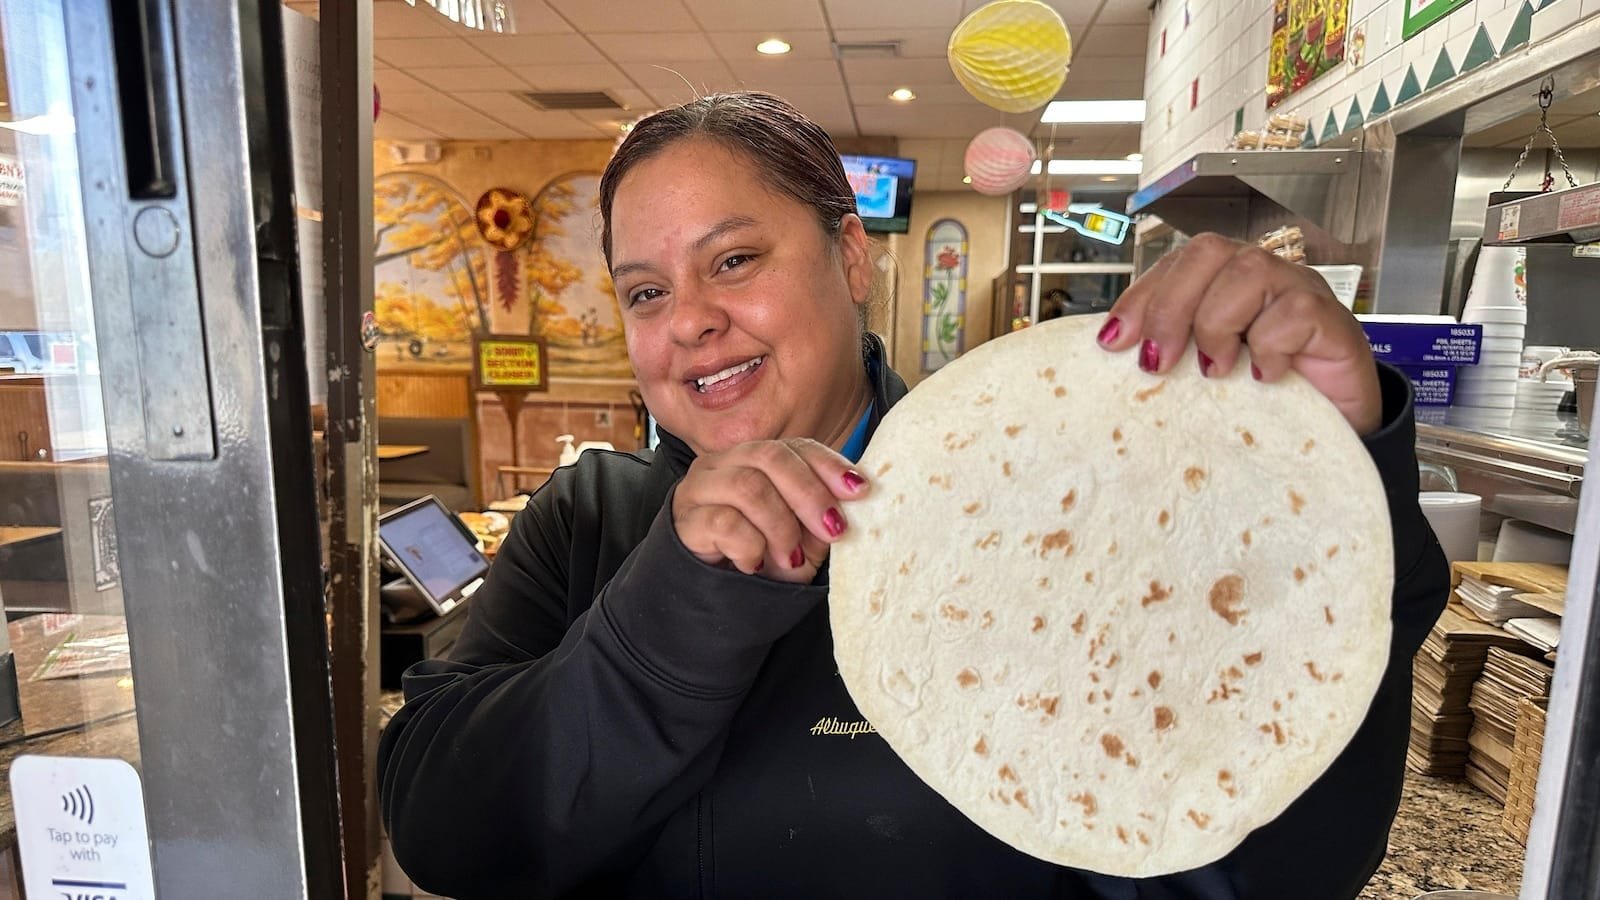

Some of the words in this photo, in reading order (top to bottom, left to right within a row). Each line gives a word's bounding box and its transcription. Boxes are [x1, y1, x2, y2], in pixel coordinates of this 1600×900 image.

[47, 827, 72, 846] Tap
[75, 831, 91, 843] to
[94, 833, 118, 848] pay
[70, 847, 102, 861] with
